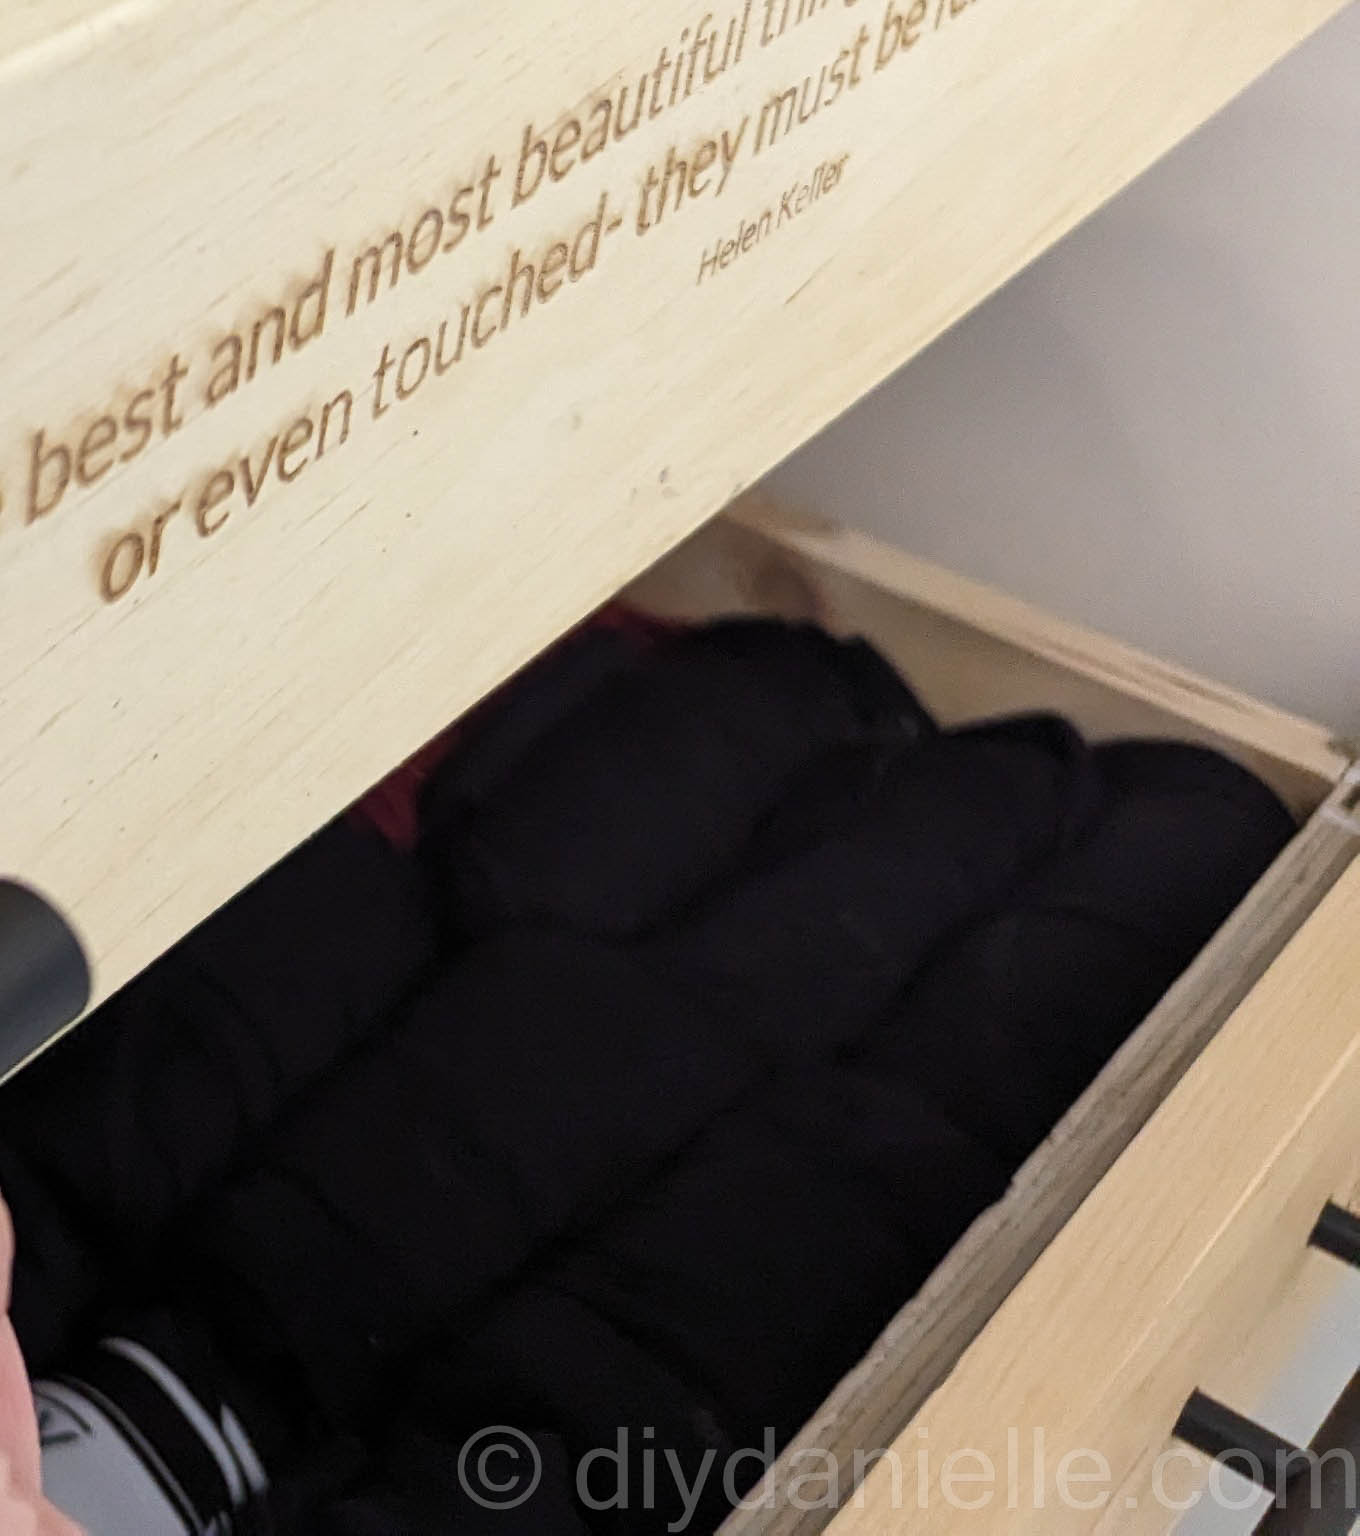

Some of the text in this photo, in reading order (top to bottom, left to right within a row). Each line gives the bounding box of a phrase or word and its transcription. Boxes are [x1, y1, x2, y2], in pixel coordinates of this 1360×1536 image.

[24, 353, 189, 527] best
[202, 248, 336, 409] and
[346, 154, 501, 318] most
[99, 498, 182, 605] or
[195, 389, 353, 538] even
[634, 115, 750, 237] they
[753, 23, 870, 155] must
[696, 152, 850, 286] Helen Keller
